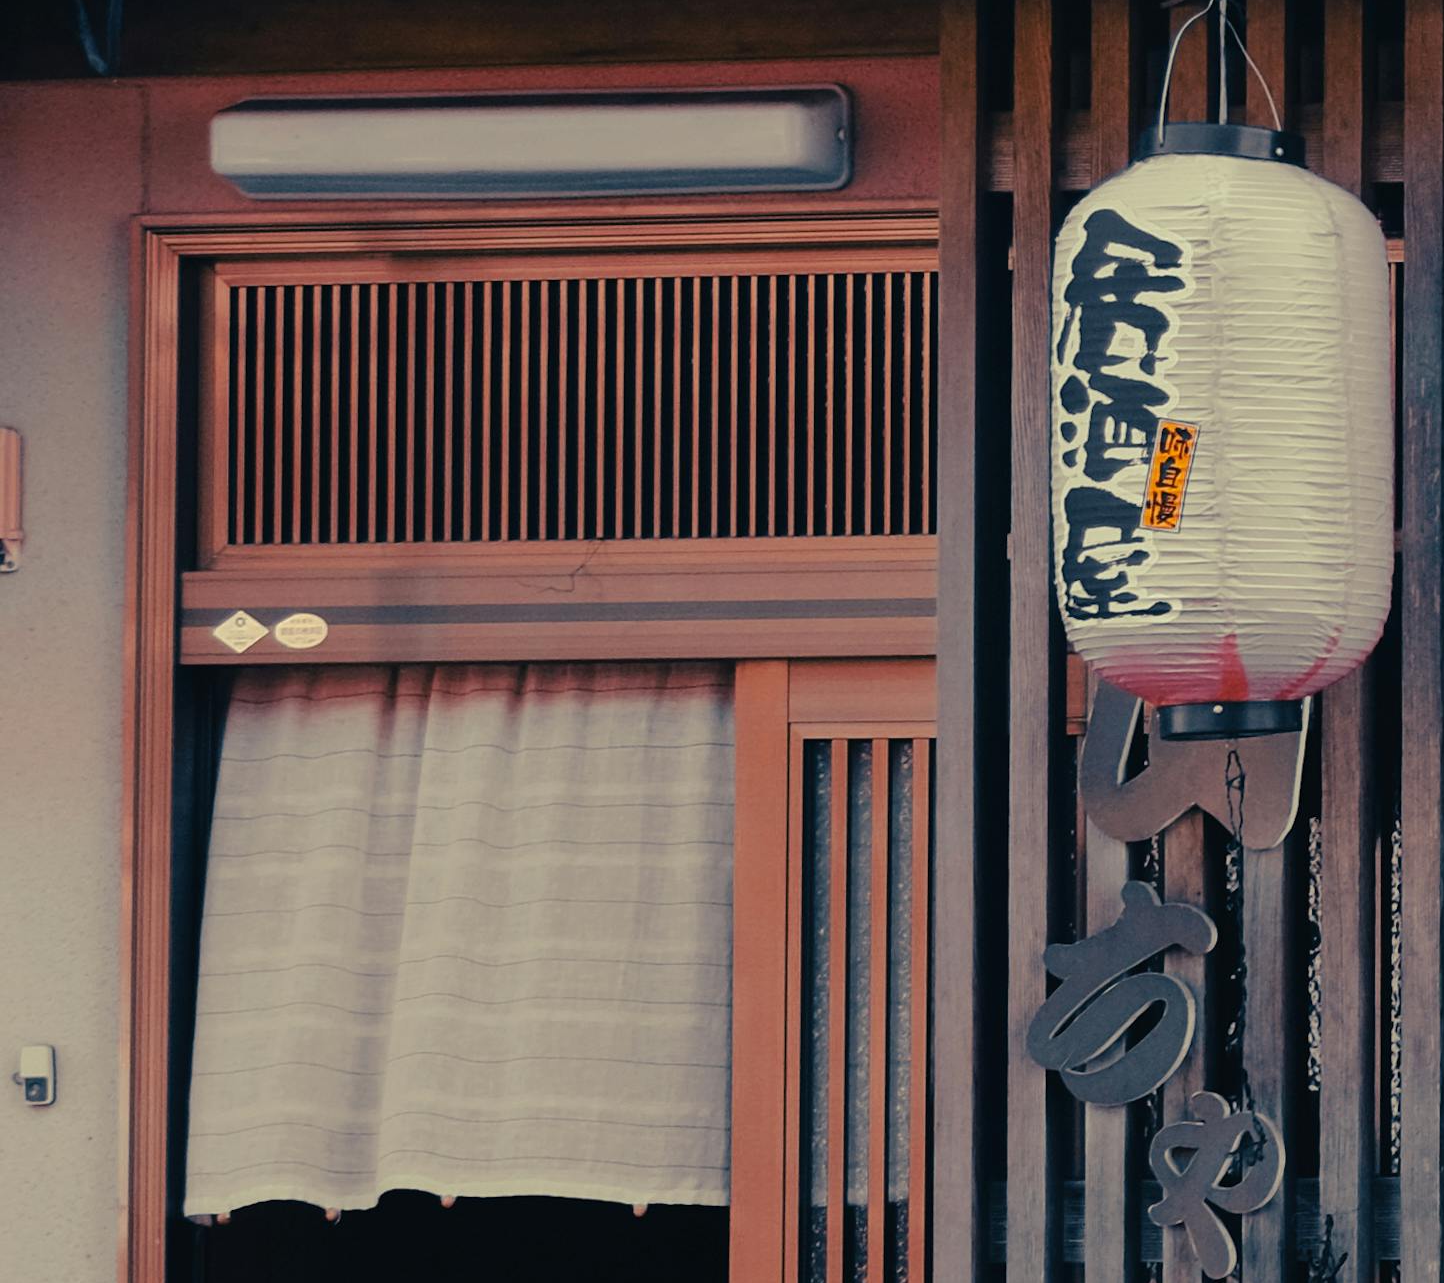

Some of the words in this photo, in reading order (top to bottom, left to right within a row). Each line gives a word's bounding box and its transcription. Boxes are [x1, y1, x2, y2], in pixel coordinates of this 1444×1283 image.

[1055, 206, 1187, 621] 居酒屋
[1145, 425, 1194, 530] 味自慢
